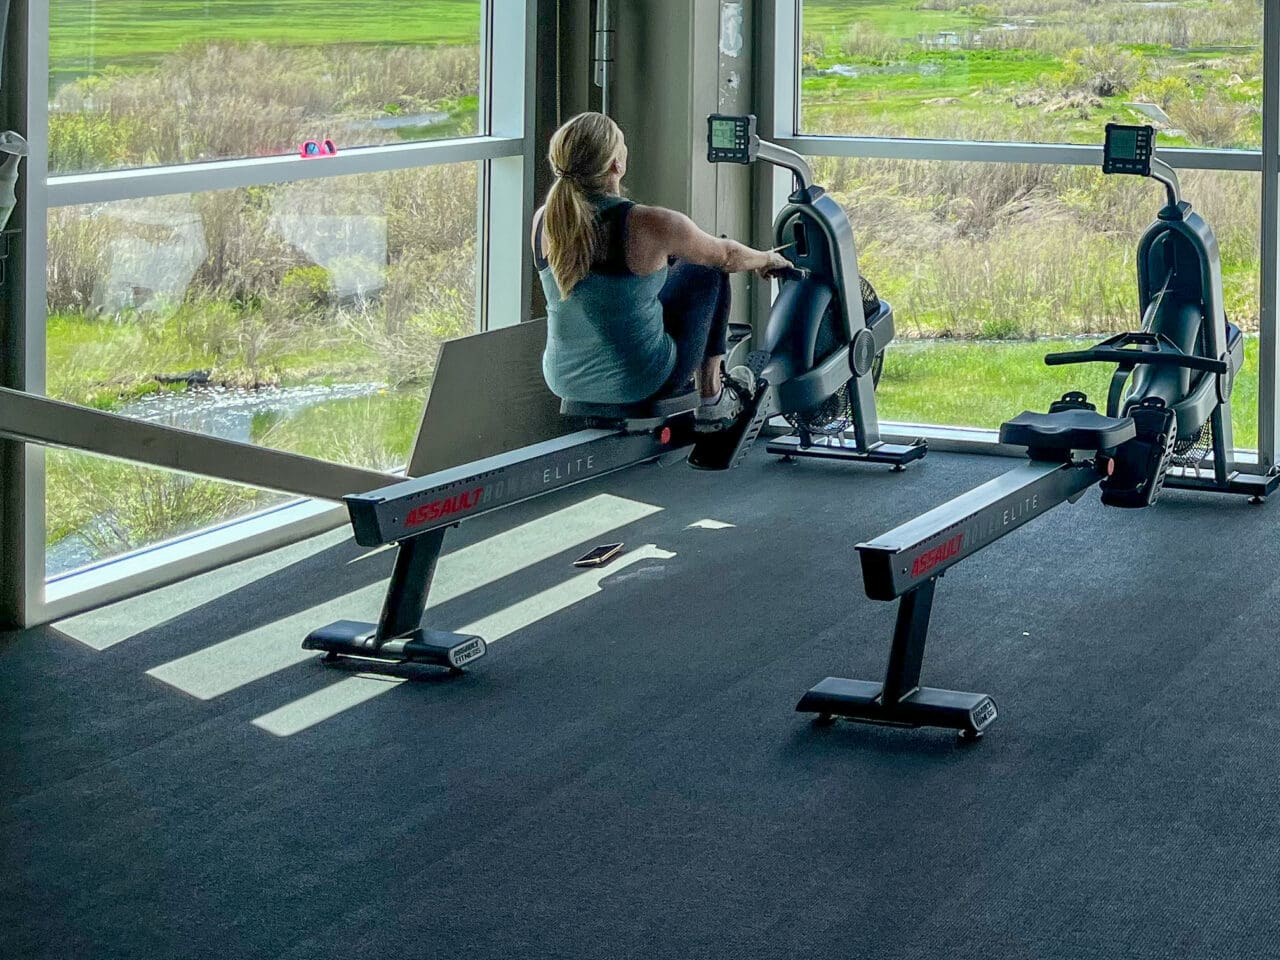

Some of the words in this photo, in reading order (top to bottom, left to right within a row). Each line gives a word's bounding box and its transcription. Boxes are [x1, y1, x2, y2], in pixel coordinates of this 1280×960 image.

[406, 488, 483, 526] ASSAULT
[543, 456, 594, 482] ELITE
[1003, 495, 1038, 525] ELITE
